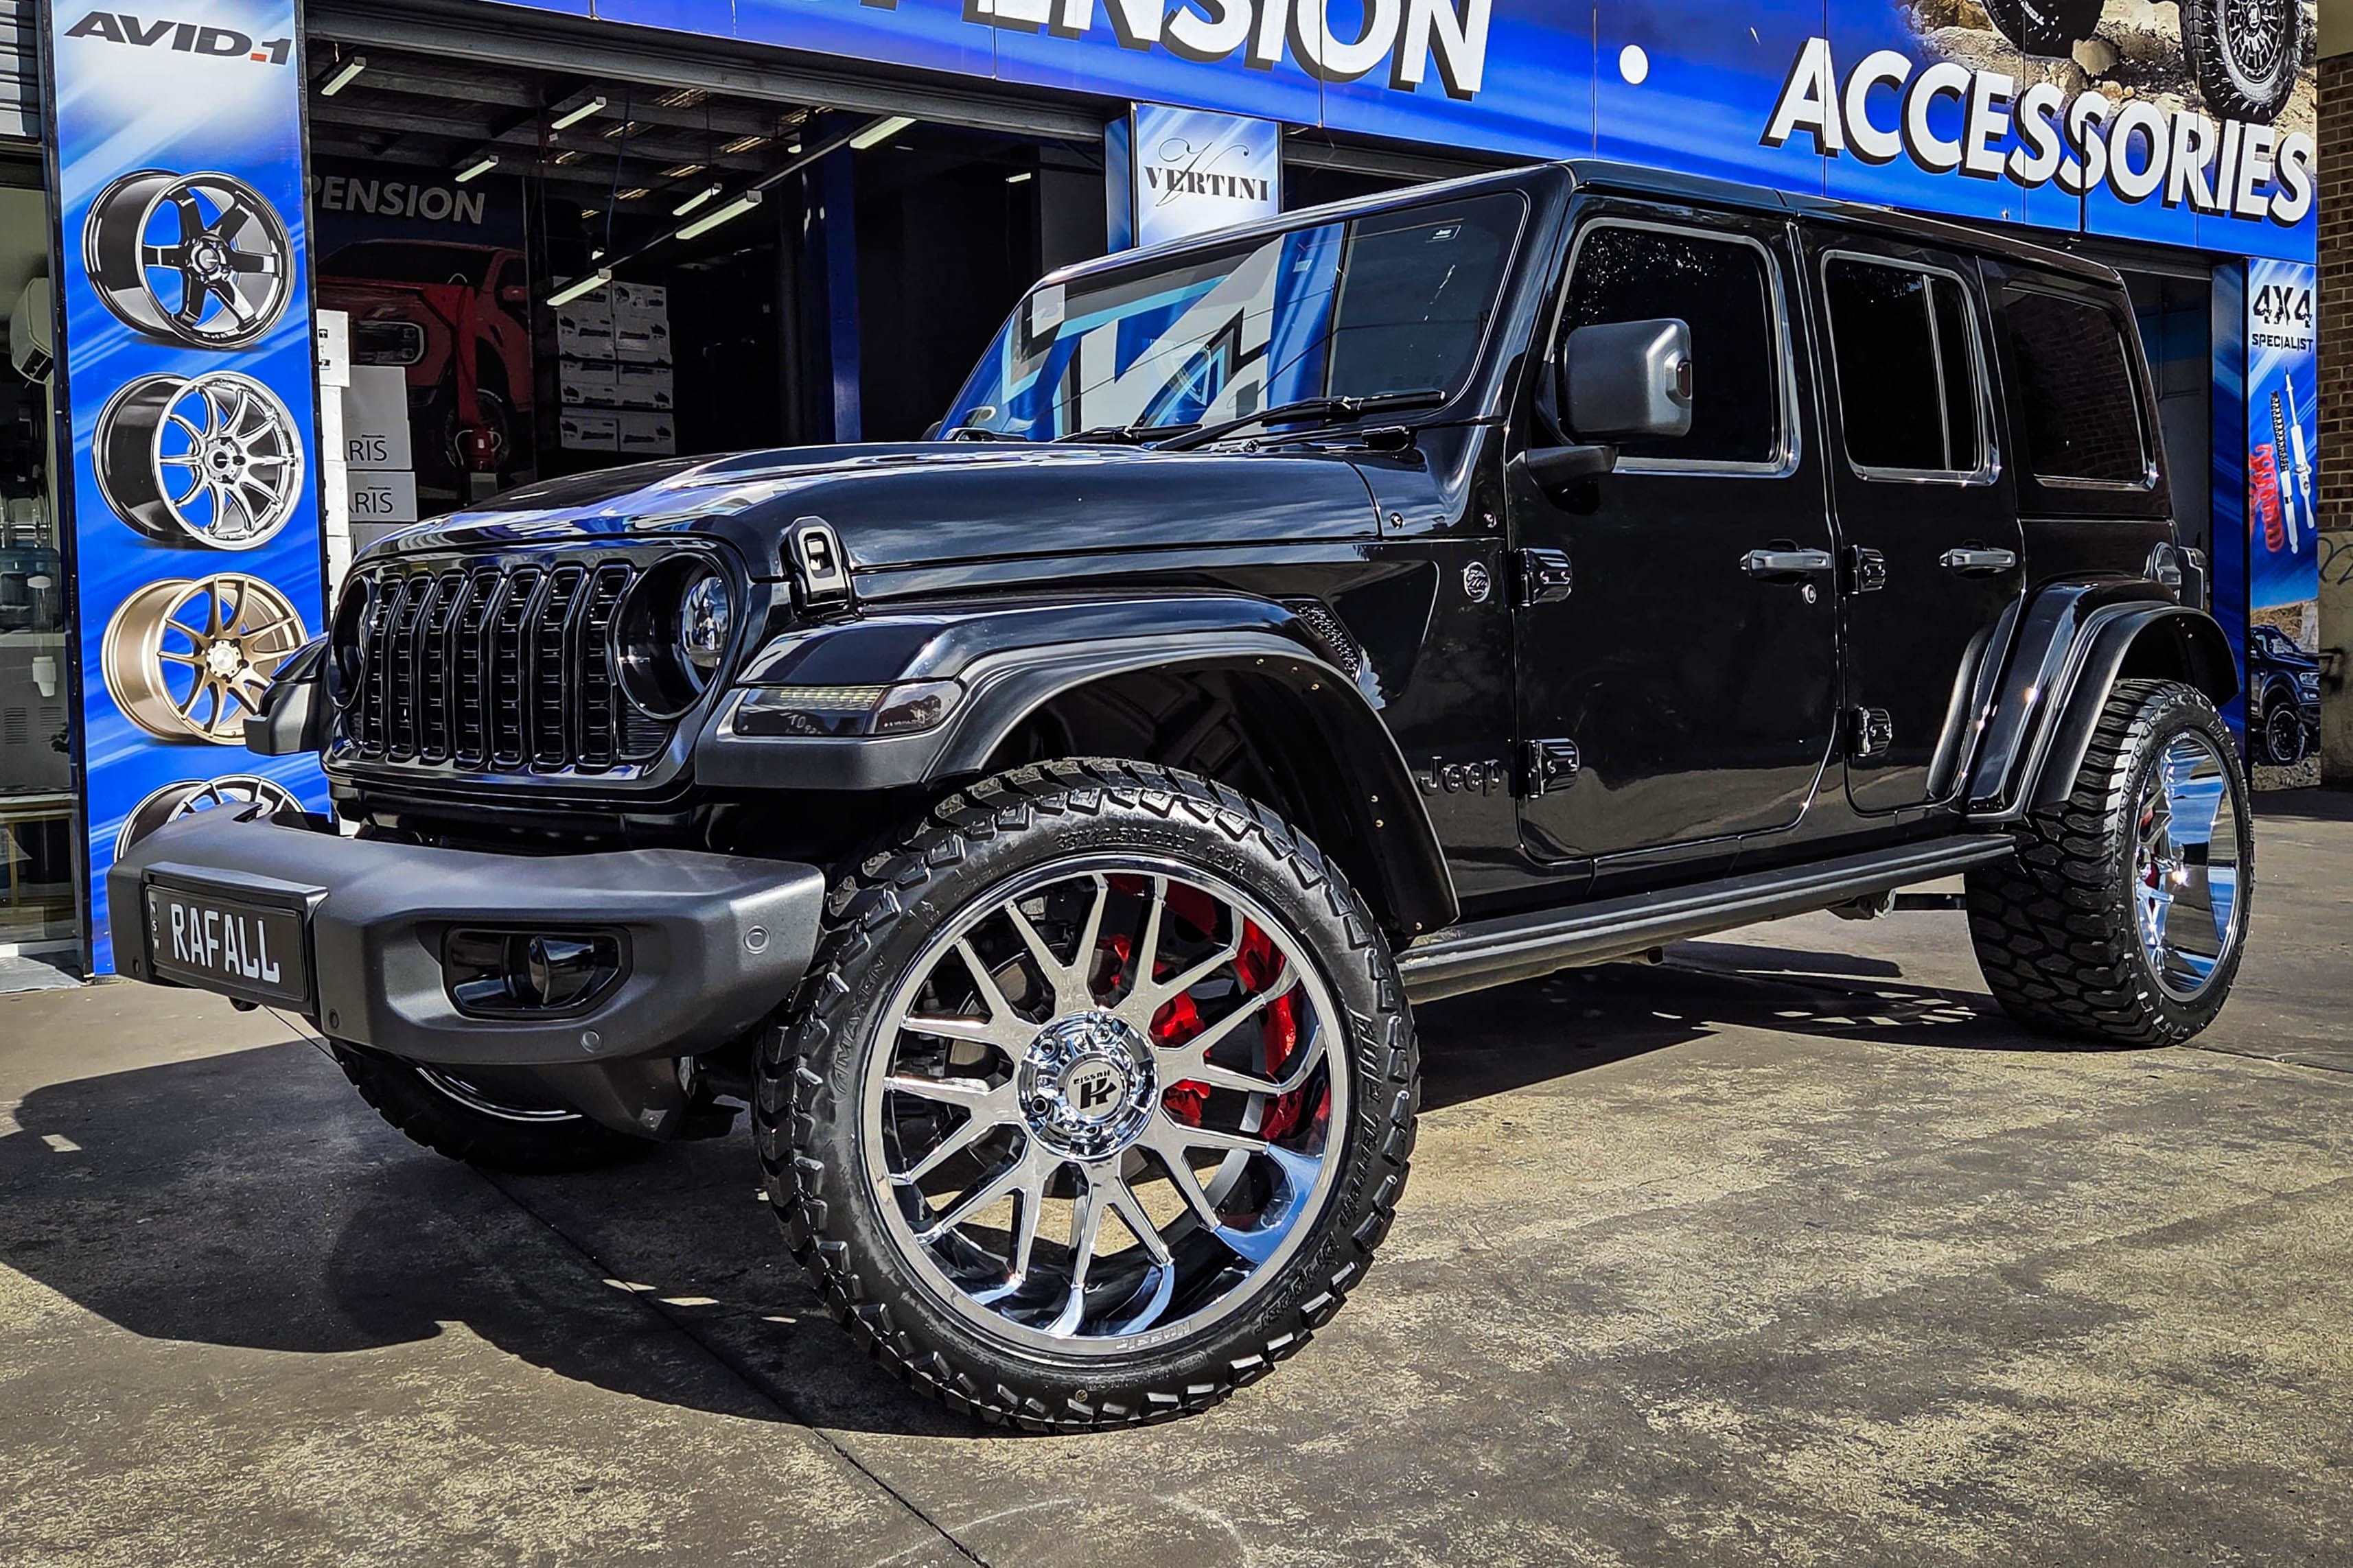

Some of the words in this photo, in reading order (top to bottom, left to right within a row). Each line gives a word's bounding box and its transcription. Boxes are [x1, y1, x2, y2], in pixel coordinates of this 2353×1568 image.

[1768, 37, 2312, 222] ACCESSORIES
[1144, 165, 1268, 201] VERTINI
[2252, 334, 2313, 353] SPECIALIST
[344, 440, 387, 461] RIS
[349, 492, 393, 513] RIS
[1418, 756, 1501, 797] Jeep
[170, 903, 280, 983] RAFALL
